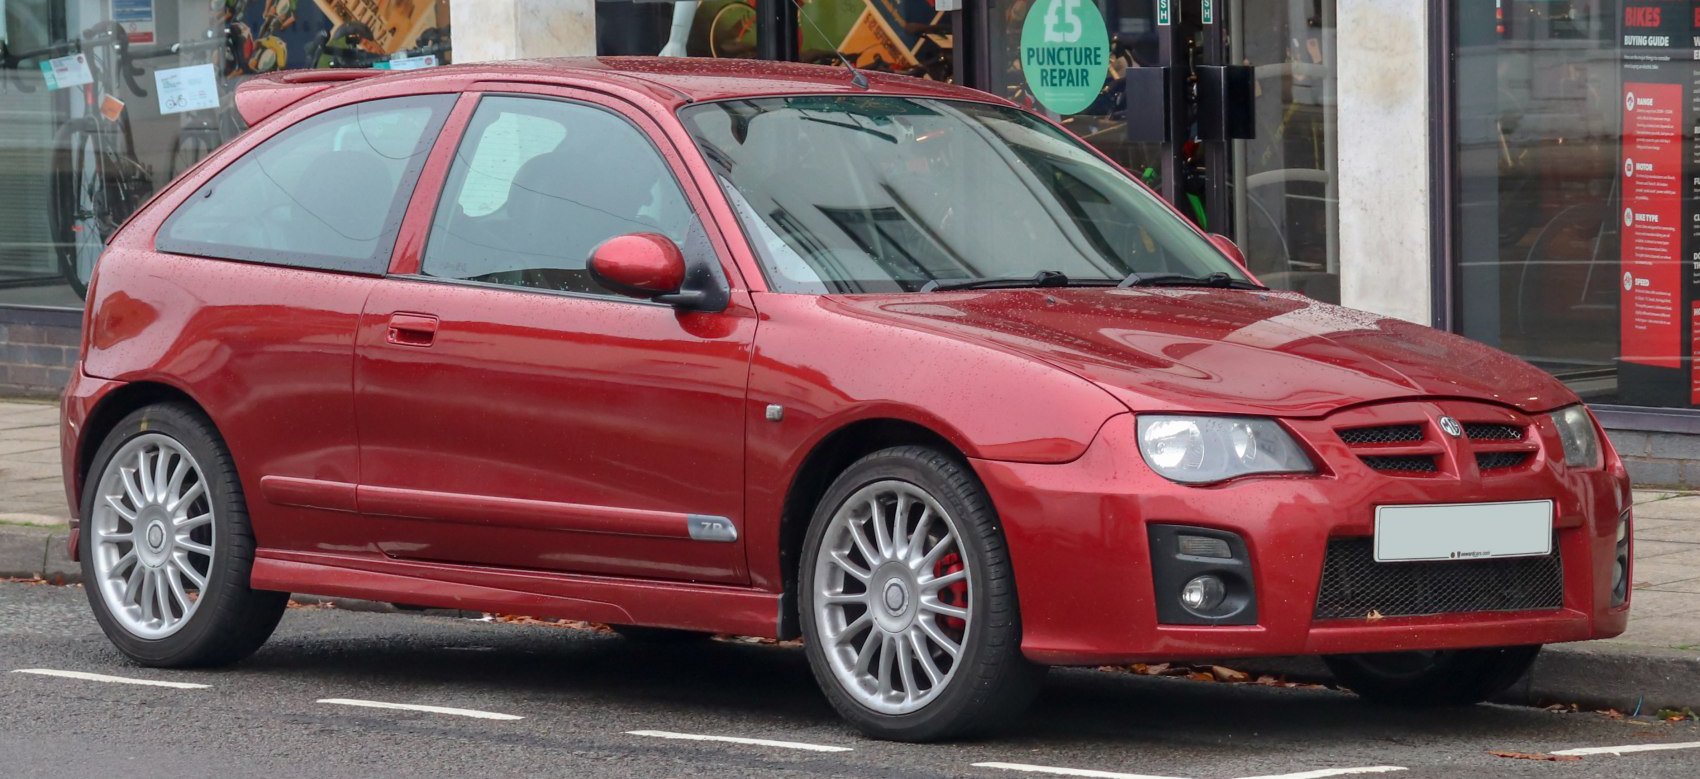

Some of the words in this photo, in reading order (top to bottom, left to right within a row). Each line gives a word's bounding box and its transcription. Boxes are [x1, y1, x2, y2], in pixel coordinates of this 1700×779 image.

[1043, 0, 1082, 43] £5
[1625, 6, 1661, 27] BIKES
[1624, 35, 1647, 46] BUYING
[1648, 36, 1669, 47] GUIDE
[1026, 47, 1102, 66] PUNCTURE
[1040, 68, 1090, 87] REPAIR
[1636, 97, 1653, 106] RANGE
[1635, 163, 1653, 171] MOTOR
[1635, 213, 1646, 222] BIKE
[1646, 214, 1659, 223] TYPE
[1440, 416, 1460, 436] MG
